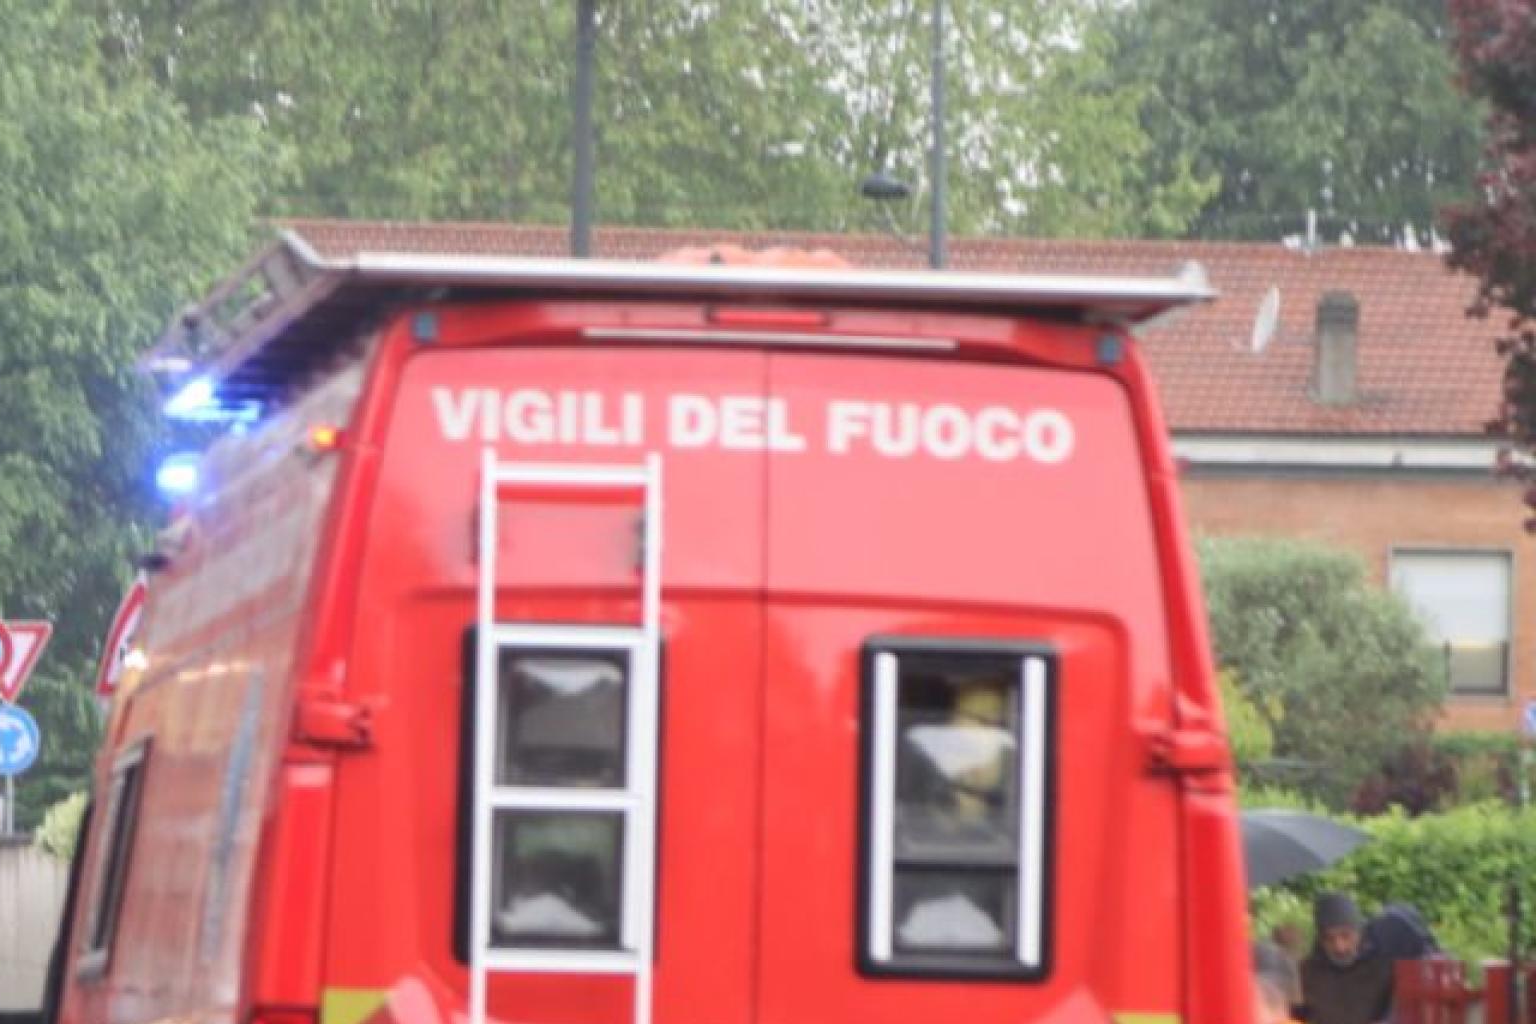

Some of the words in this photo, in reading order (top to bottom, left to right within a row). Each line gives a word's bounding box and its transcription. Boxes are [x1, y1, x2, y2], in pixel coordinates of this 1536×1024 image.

[432, 387, 643, 445] VIGILI
[668, 395, 806, 453] DEL
[827, 401, 1075, 462] FUOCO
